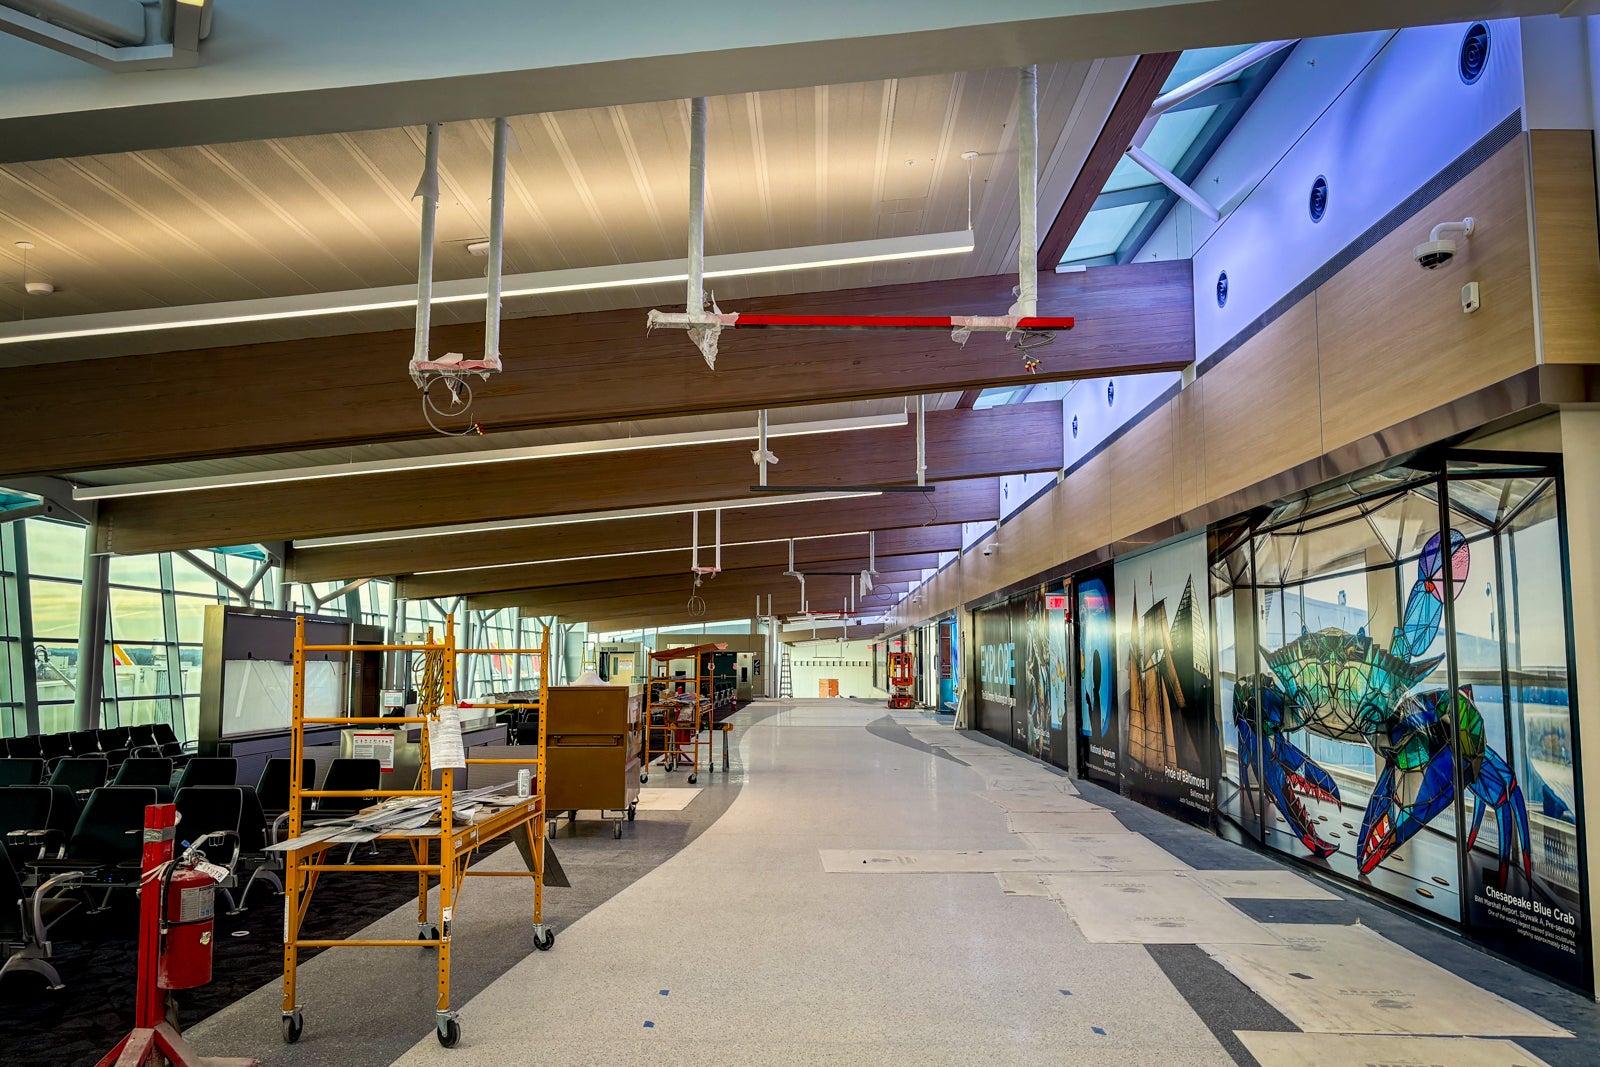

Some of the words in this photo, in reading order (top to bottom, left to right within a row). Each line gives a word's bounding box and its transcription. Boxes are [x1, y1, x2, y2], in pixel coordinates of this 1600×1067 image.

[981, 642, 1016, 686] EXPLORE
[1165, 765, 1176, 780] Pride
[1176, 769, 1181, 781] of
[1182, 770, 1205, 789] Baltimore
[1205, 777, 1210, 790] II
[1484, 898, 1501, 910] Marshall
[1519, 910, 1538, 923] Skywalk
[1545, 920, 1576, 938] Pre-security
[1486, 885, 1531, 911] Chesapeake
[1533, 901, 1552, 918] Blue
[1553, 908, 1575, 926] Crab
